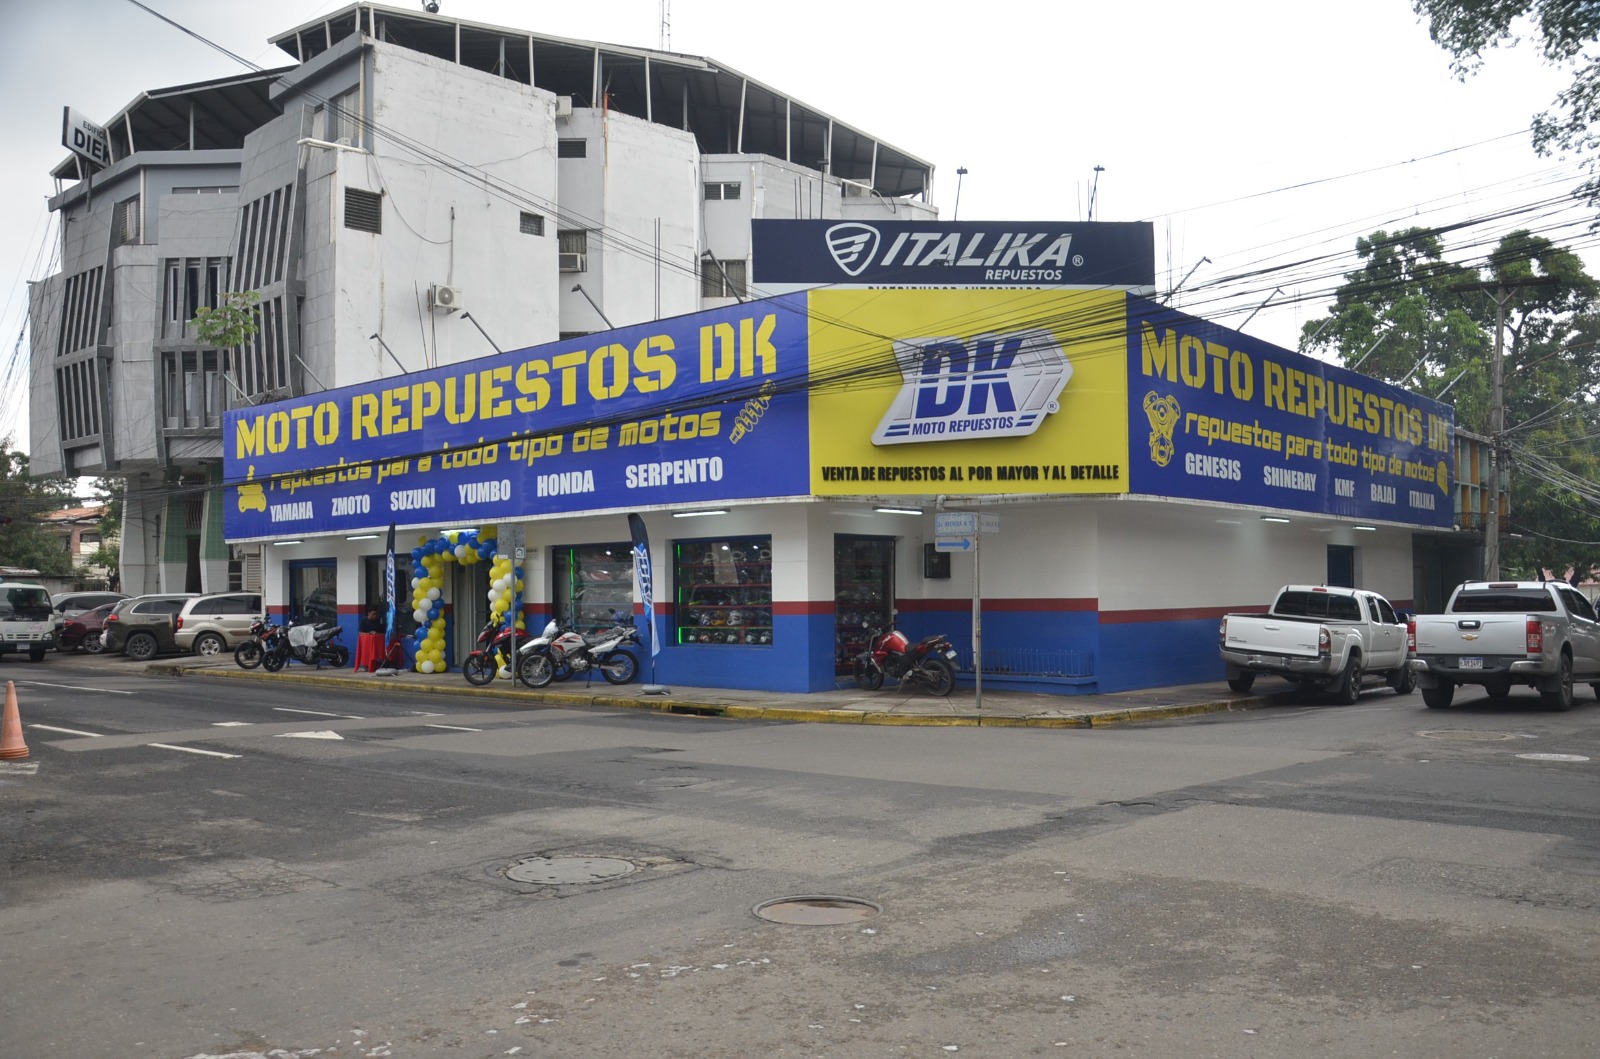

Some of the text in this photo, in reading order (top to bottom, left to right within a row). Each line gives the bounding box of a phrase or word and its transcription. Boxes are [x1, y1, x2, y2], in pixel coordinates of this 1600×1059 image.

[880, 232, 1073, 266] ITALIKA
[985, 269, 1062, 280] REPUESTOS
[236, 313, 776, 460] MOTO REPUESTOS DK
[915, 337, 1024, 419] DK
[1141, 320, 1449, 453] MOTO REPUESTOS DK
[270, 457, 372, 495] repuestos
[441, 436, 498, 469] todo
[508, 429, 563, 466] tipo
[572, 422, 609, 453] de
[618, 409, 722, 447] motos
[912, 416, 1014, 436] MOTO REPUESTOS
[1185, 412, 1435, 483] repuestos para todo tipo de motos
[270, 456, 723, 522] YAMAHA ZMOTO SUZUKI YUMBO HONDA SERPENTO
[822, 465, 1119, 481] VENTA DE REPUESTOS AL POR MAYOR Y AL DETALLE
[1185, 452, 1435, 511] GENESIS SHINERAY KMF BAJAJ ITALIKA
